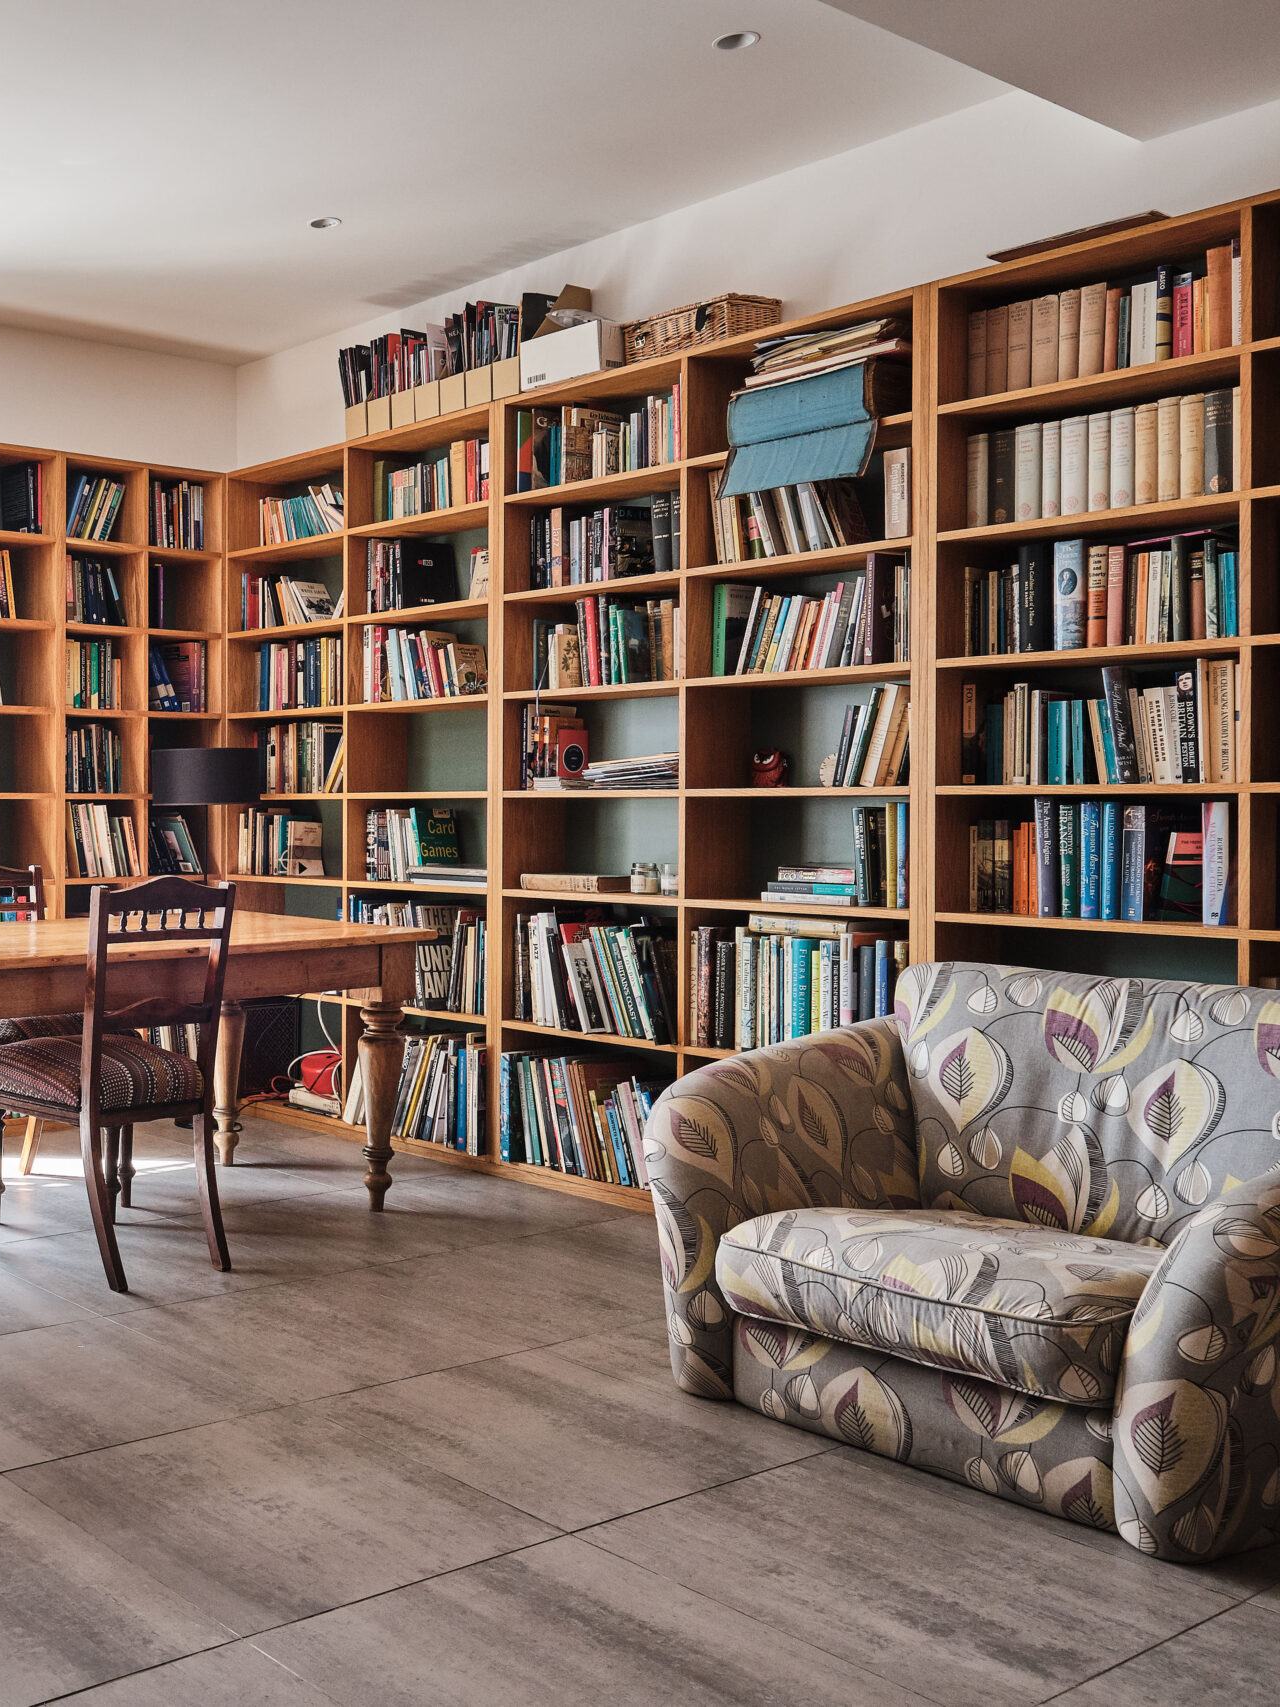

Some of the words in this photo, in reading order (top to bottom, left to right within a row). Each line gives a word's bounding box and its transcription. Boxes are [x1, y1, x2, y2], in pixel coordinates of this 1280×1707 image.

[1180, 293, 1188, 328] ENIGMA
[890, 464, 900, 492] Repair
[552, 528, 562, 547] Jazz
[1220, 665, 1228, 678] THE
[1168, 694, 1176, 709] JOHN
[1221, 678, 1229, 710] CHANGING
[1155, 700, 1164, 732] BERNARD
[1177, 701, 1186, 738] BRITAIN
[1185, 701, 1195, 739] BROWN'S
[1152, 728, 1160, 763] MESSENGER
[1159, 735, 1167, 762] INGHAM
[1188, 741, 1196, 768] ROBERT
[1222, 740, 1229, 748] OF
[1222, 748, 1230, 772] BRITAIN
[427, 819, 456, 835] Card
[1059, 809, 1068, 856] FRANCE
[420, 842, 459, 858] Games
[418, 945, 452, 971] UNB
[799, 948, 807, 979] FLORA
[425, 972, 450, 998] AM
[742, 959, 750, 985] Healing
[616, 961, 631, 996] BRITAIN'S
[626, 996, 637, 1021] COAST
[798, 985, 807, 1036] BRITANNIC
[402, 1046, 413, 1070] PICASSO
